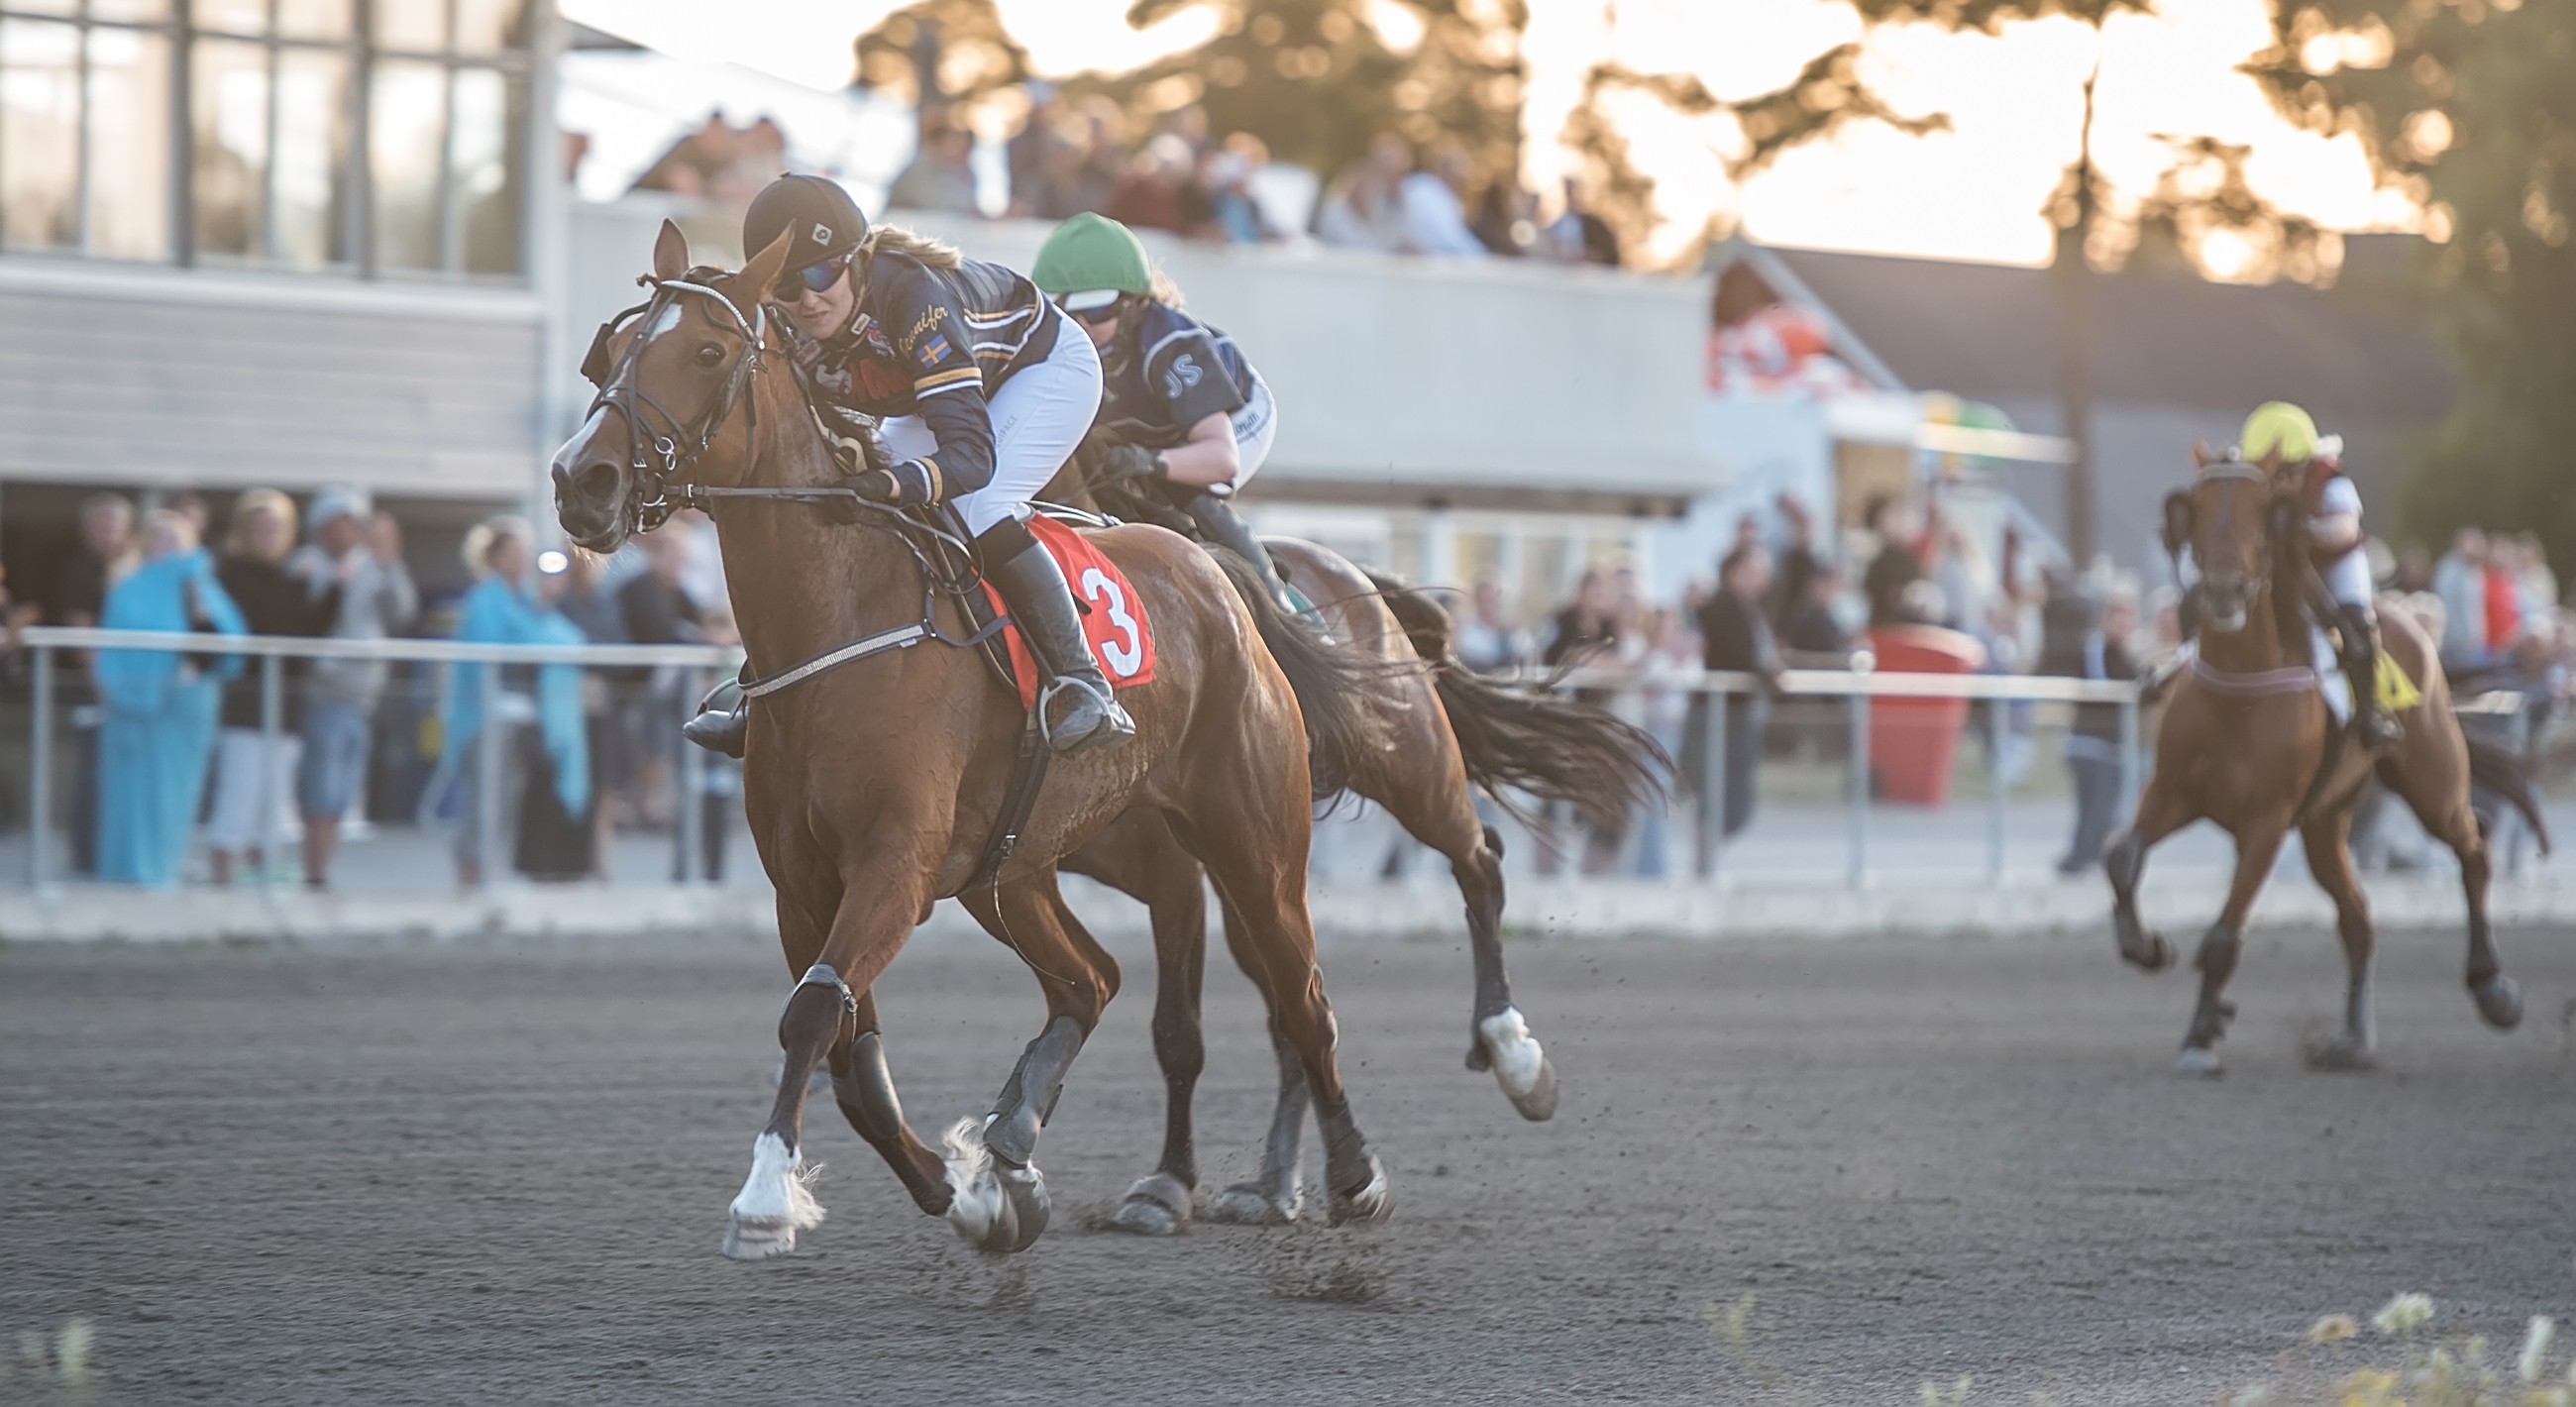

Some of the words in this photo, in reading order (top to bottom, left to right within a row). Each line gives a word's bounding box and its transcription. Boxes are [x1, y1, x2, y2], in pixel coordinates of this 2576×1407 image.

[1164, 354, 1204, 398] JS
[996, 414, 1020, 448] UIPAGE
[1081, 567, 1142, 678] 3
